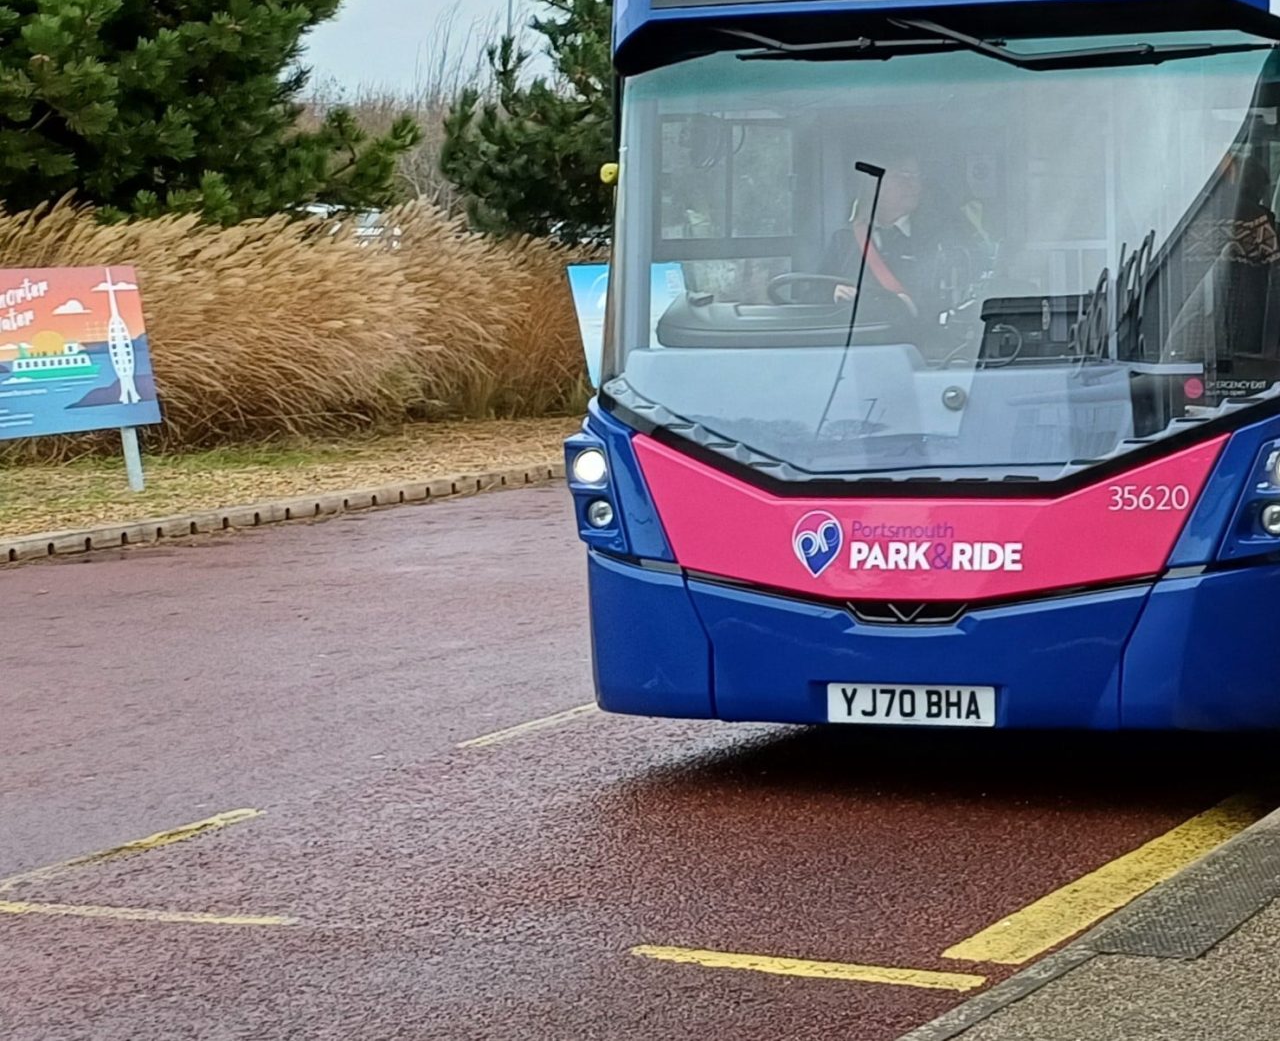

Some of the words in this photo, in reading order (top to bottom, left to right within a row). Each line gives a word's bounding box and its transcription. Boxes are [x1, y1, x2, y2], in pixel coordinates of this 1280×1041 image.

[1108, 484, 1189, 510] 35620
[852, 520, 955, 539] Portsmouth
[841, 688, 916, 717] YJ70
[925, 690, 981, 719] BHA
